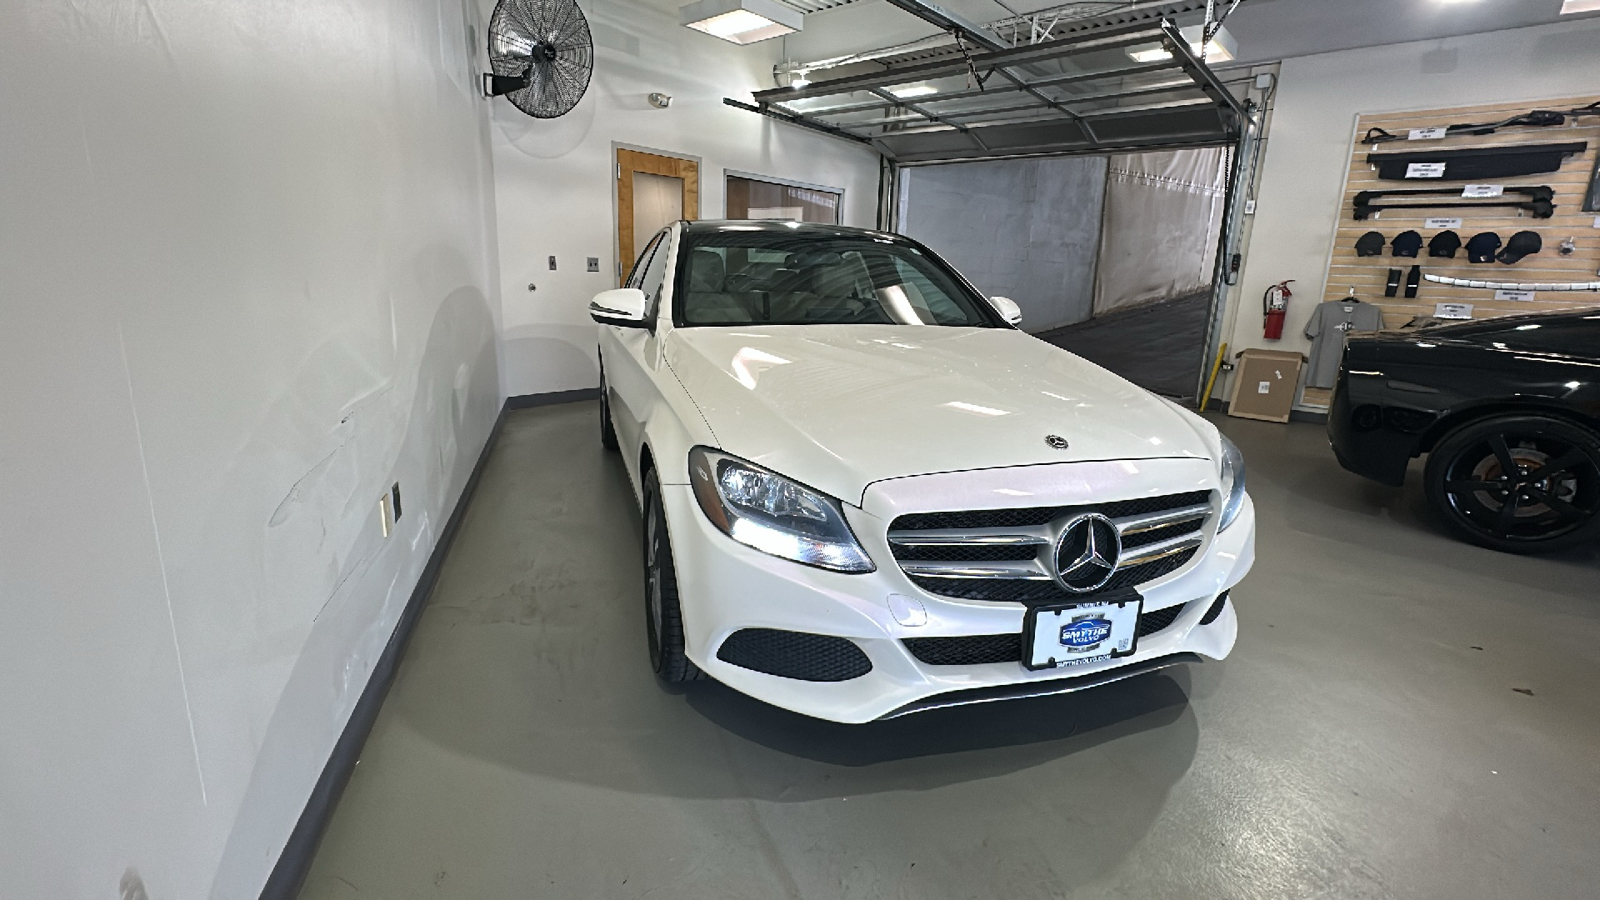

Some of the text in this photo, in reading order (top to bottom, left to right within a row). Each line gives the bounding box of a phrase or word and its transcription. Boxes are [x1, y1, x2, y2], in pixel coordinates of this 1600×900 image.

[1062, 628, 1107, 640] SMYTHE
[1072, 635, 1099, 644] VOLVO
[1056, 655, 1112, 668] SMYTHEVOLVO.COM
